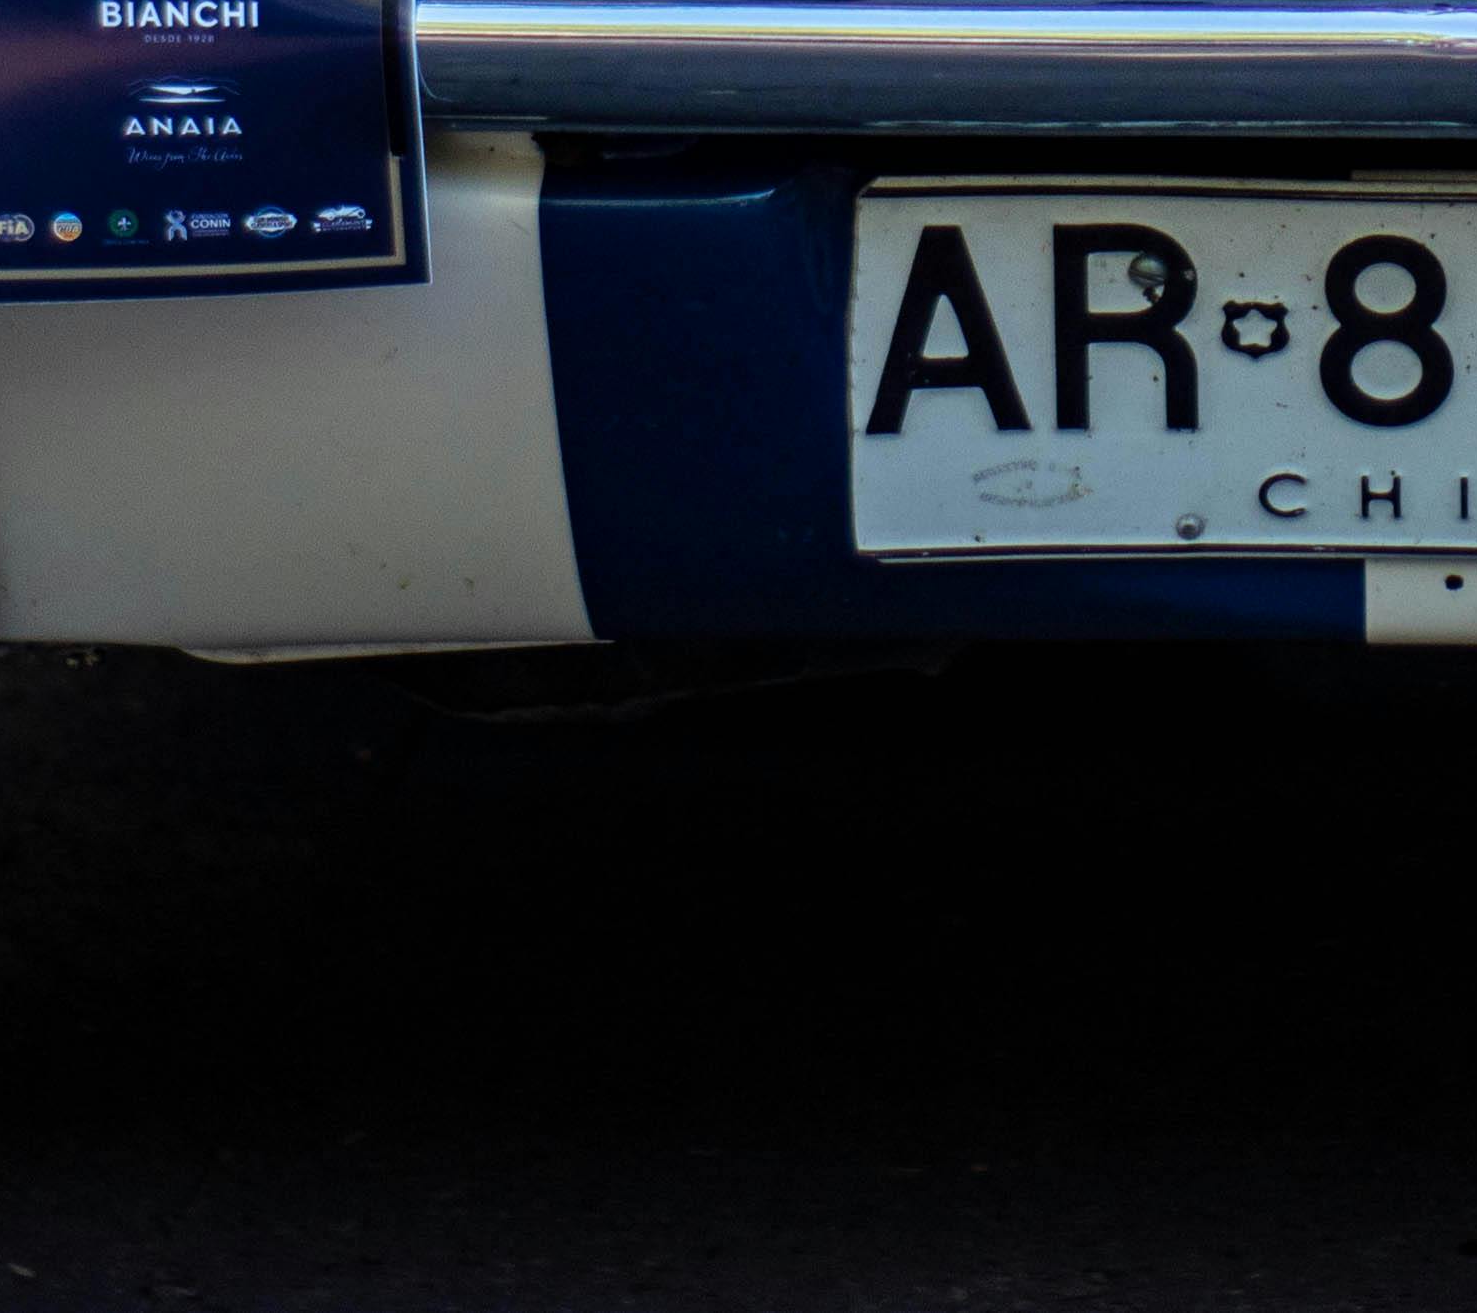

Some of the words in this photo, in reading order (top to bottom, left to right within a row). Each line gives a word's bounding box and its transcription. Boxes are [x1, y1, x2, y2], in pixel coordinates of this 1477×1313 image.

[100, 0, 259, 28] BIANCHI
[125, 117, 243, 136] ANAIA
[190, 218, 231, 230] CONIN
[865, 223, 1200, 435] AR
